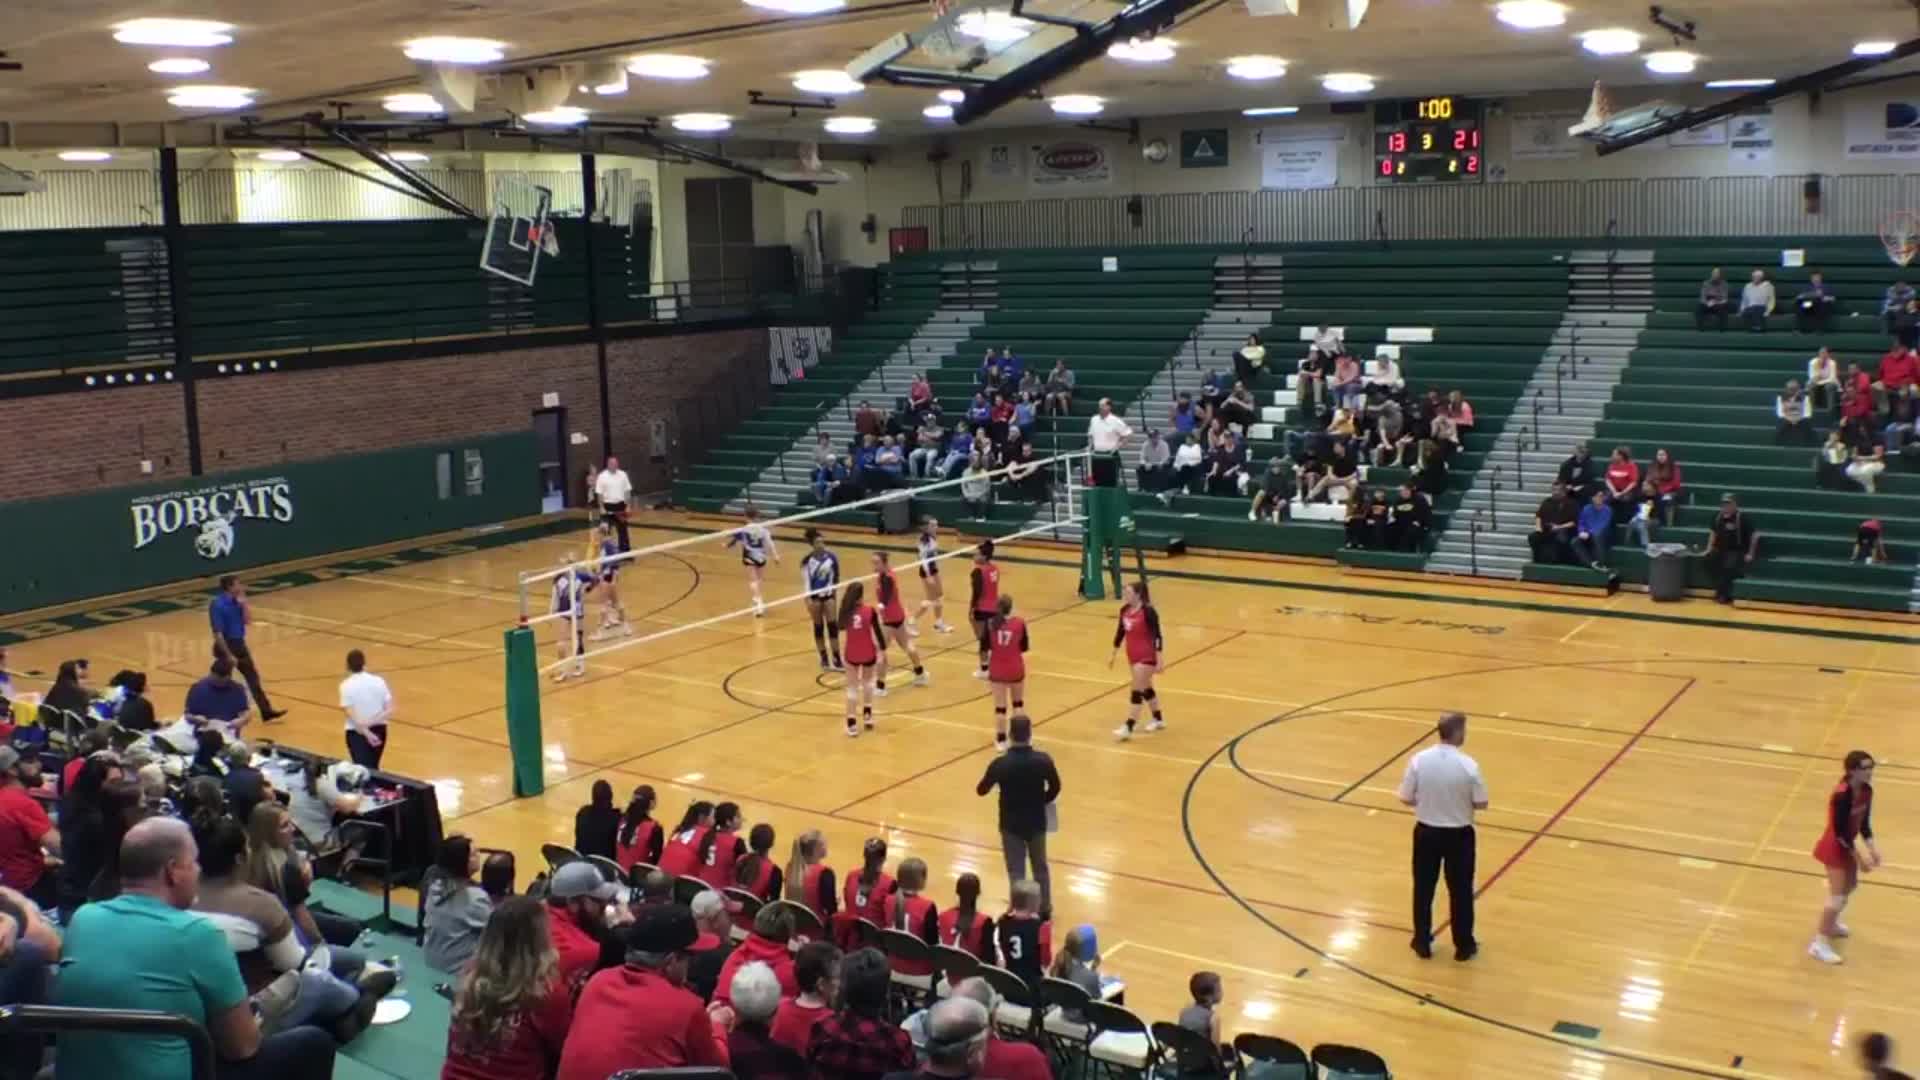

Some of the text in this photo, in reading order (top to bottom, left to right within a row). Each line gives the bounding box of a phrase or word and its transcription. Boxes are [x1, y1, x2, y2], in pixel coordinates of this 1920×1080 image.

[1419, 98, 1451, 118] 1:00
[1389, 133, 1405, 152] 13
[1422, 133, 1432, 150] 3
[1454, 130, 1477, 150] 21
[1382, 160, 1393, 175] 0
[1467, 155, 1478, 172] 2
[131, 484, 292, 549] BOBCATS
[853, 614, 863, 630] 2
[998, 629, 1012, 646] 17
[1009, 936, 1022, 959] 3
